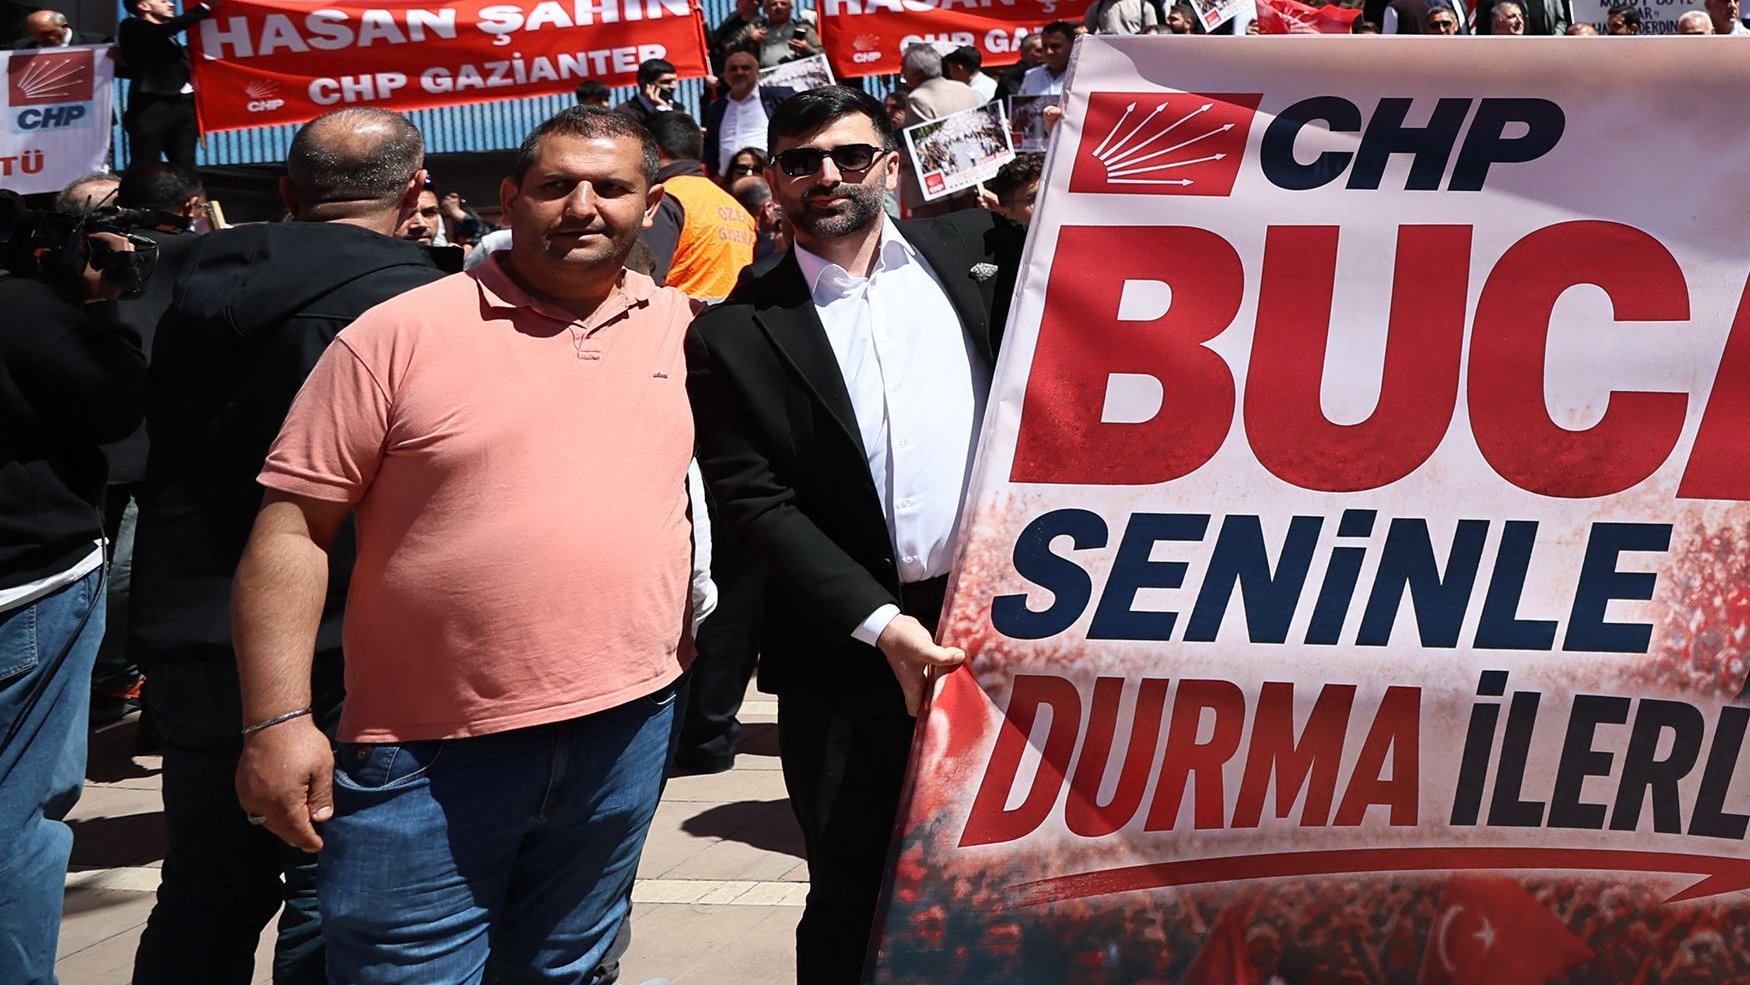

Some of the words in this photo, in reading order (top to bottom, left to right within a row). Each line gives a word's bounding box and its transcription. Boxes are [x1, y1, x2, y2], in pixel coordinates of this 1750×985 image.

[202, 8, 457, 61] HASAN
[852, 52, 881, 63] CHP
[247, 98, 284, 113] CHP
[308, 72, 408, 105] CHP
[17, 105, 86, 130] CHP
[1259, 96, 1566, 192] CHP
[991, 507, 1672, 654] SENİNLE
[958, 674, 1423, 848] DURMA
